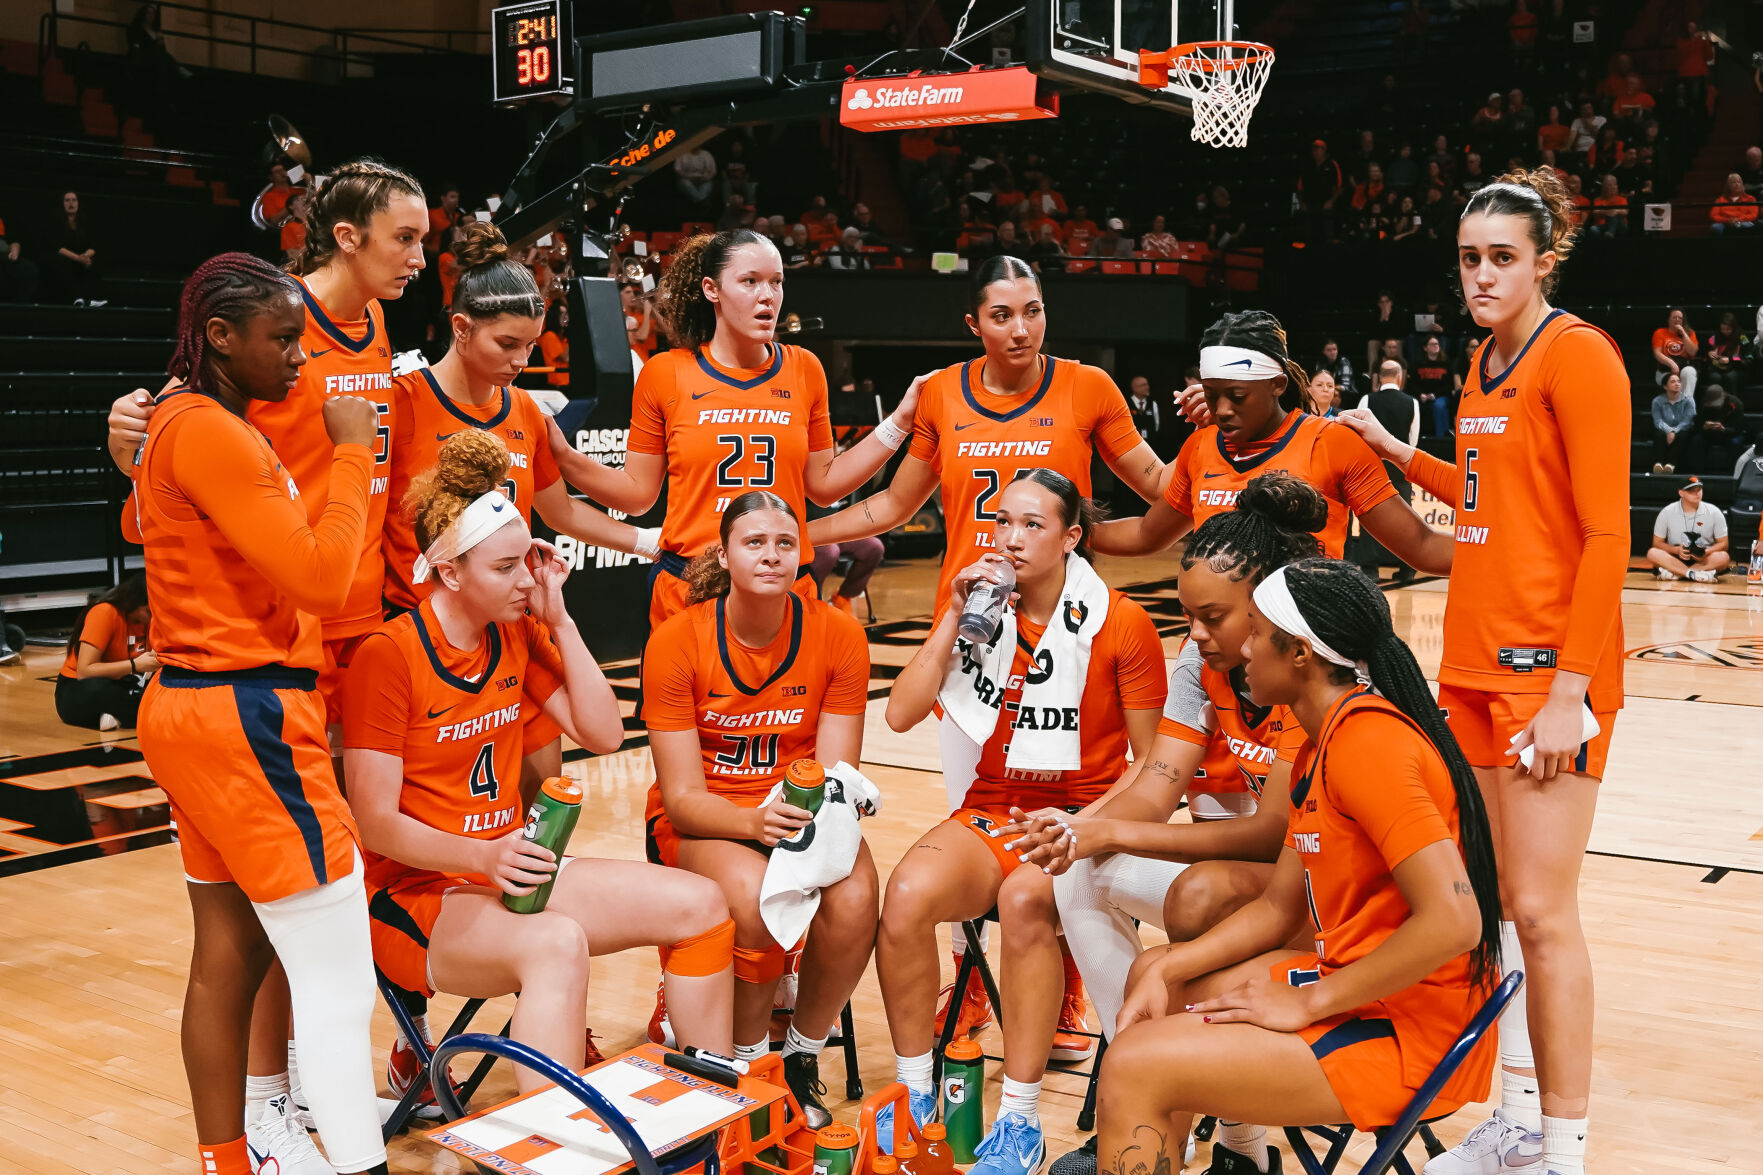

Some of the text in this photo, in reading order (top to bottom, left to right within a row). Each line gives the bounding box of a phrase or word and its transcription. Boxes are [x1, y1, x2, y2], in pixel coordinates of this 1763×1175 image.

[517, 15, 556, 45] 2:41
[517, 46, 550, 85] 30
[325, 373, 392, 394] FIGHTING
[697, 409, 791, 425] FIGHTING
[374, 403, 390, 464] 5
[717, 433, 777, 488] 23
[957, 441, 1052, 457] FIGHTING
[1463, 448, 1479, 512] 6
[1199, 490, 1243, 506] FIGH
[1455, 525, 1490, 545] LLINI
[1536, 653, 1548, 662] 46
[436, 702, 521, 743] FIGHTING
[703, 708, 805, 728] FIGHTING
[1016, 706, 1079, 732] ADE
[468, 741, 500, 802] 4
[462, 806, 515, 833] ILLINI
[622, 1055, 760, 1106] FIGHTING ILLINI
